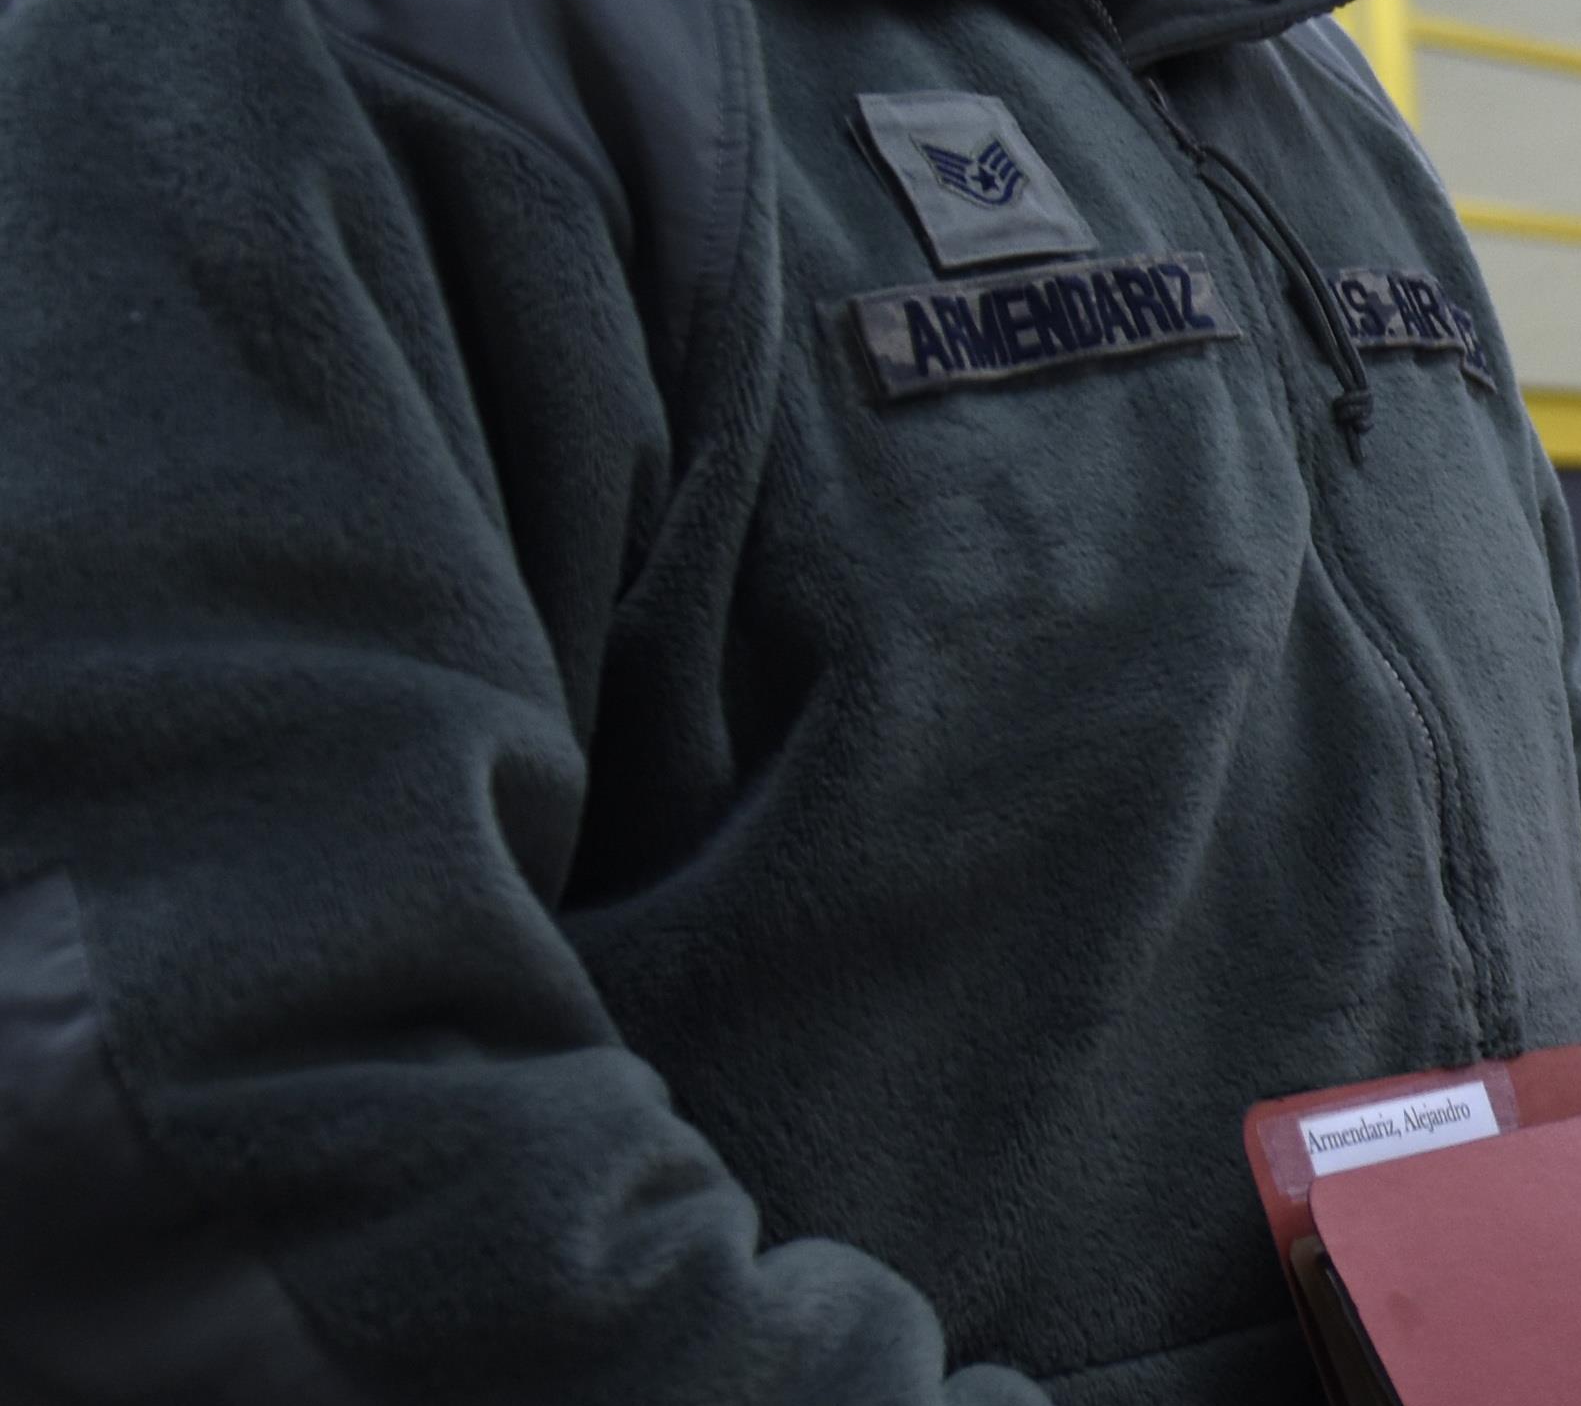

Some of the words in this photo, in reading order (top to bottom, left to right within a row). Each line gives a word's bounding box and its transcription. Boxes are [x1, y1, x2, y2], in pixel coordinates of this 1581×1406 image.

[904, 262, 1215, 378] ARMENDARIZ
[1306, 1112, 1403, 1155] Armendariz,
[1402, 1098, 1472, 1134] Alejandro
